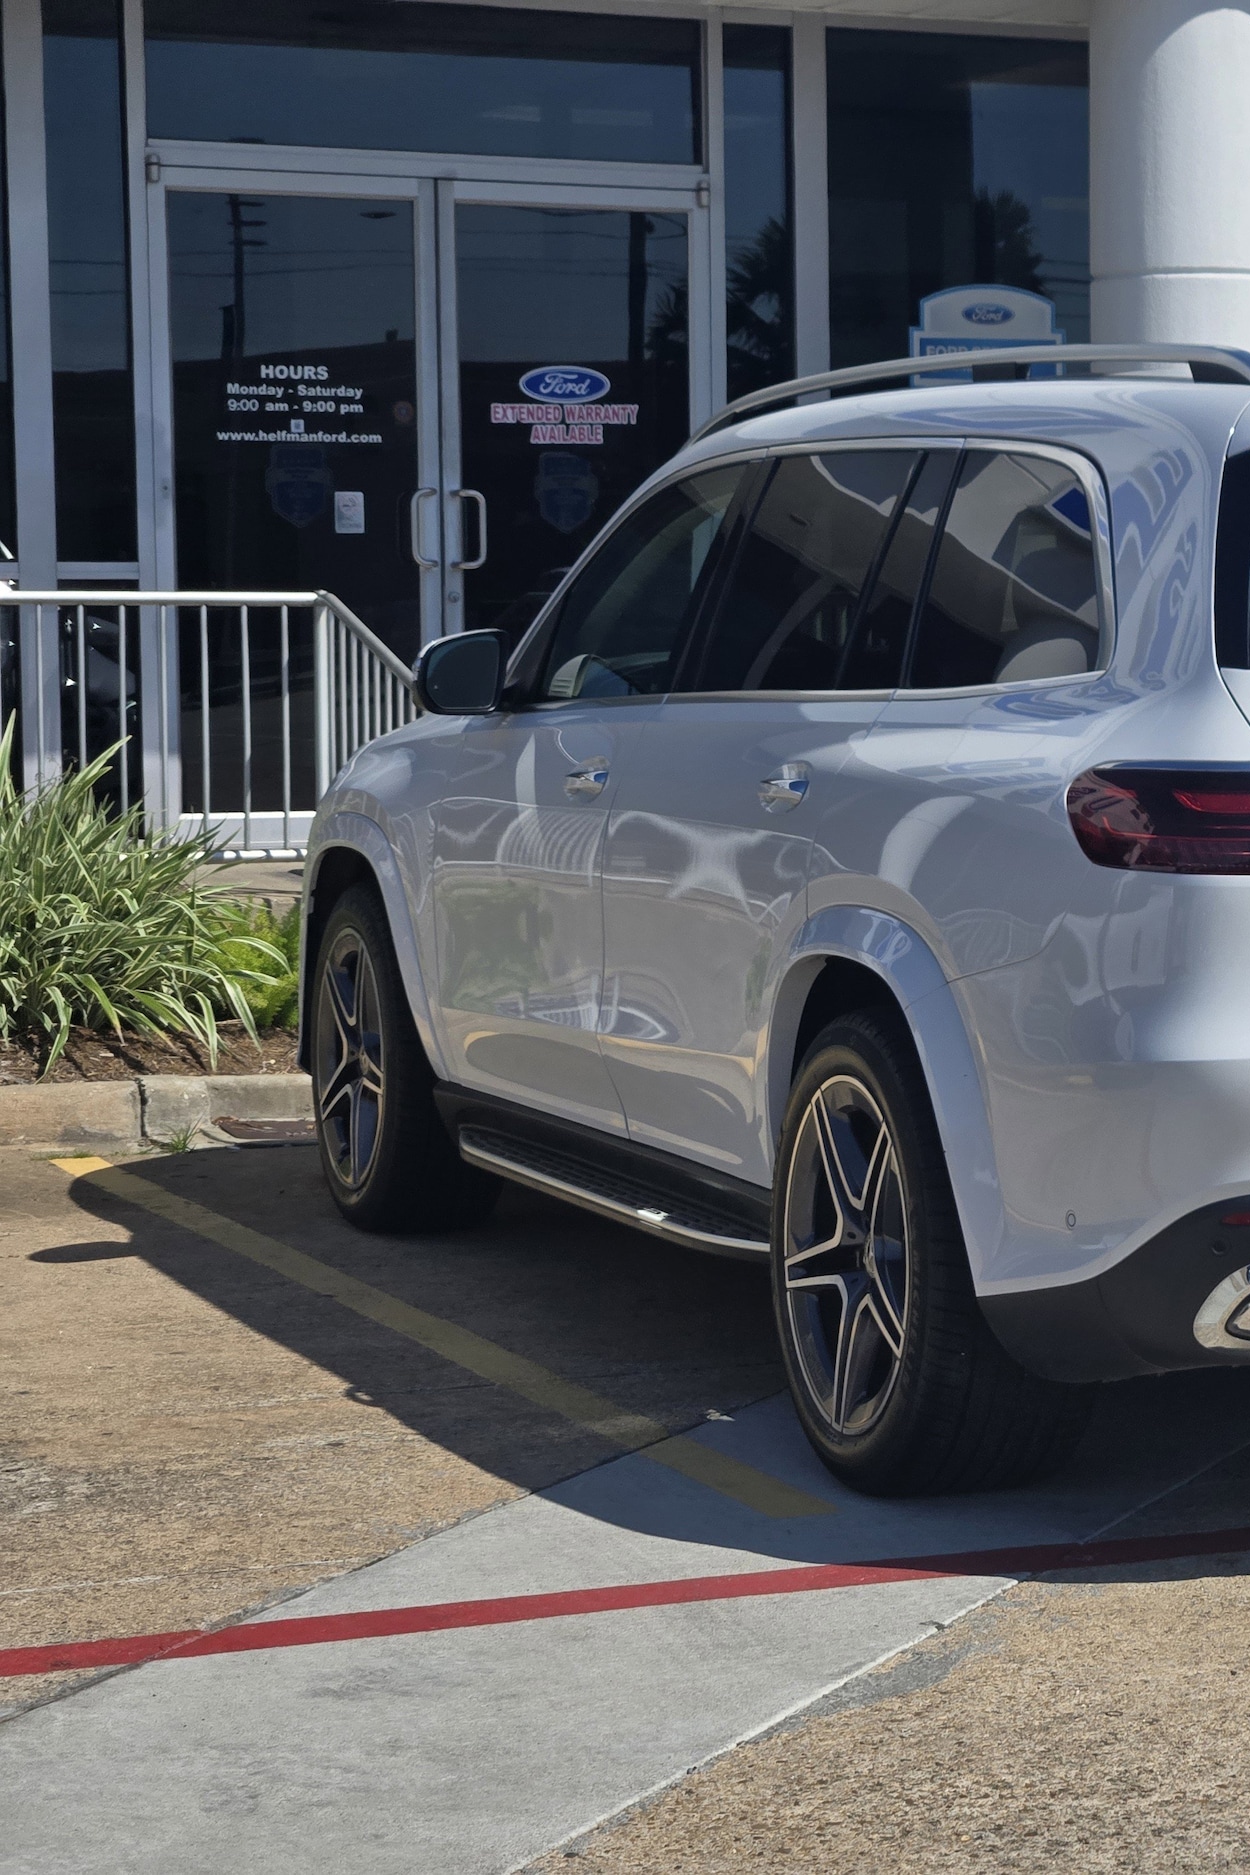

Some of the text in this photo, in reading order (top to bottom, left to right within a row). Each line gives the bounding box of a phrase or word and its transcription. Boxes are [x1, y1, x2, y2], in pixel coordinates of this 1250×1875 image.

[972, 306, 1004, 321] Ford
[260, 365, 329, 380] HOURS
[227, 383, 284, 398] Monday
[297, 384, 363, 399] Saturday
[539, 373, 591, 395] Ford
[228, 399, 259, 411] 9:00
[265, 402, 289, 411] am
[303, 401, 335, 412] 9:00
[340, 403, 364, 415] pm
[491, 403, 638, 424] EXTENDED WARRANTY
[216, 430, 382, 443] www.helfmanford.com
[531, 425, 603, 444] AVAILABLE
